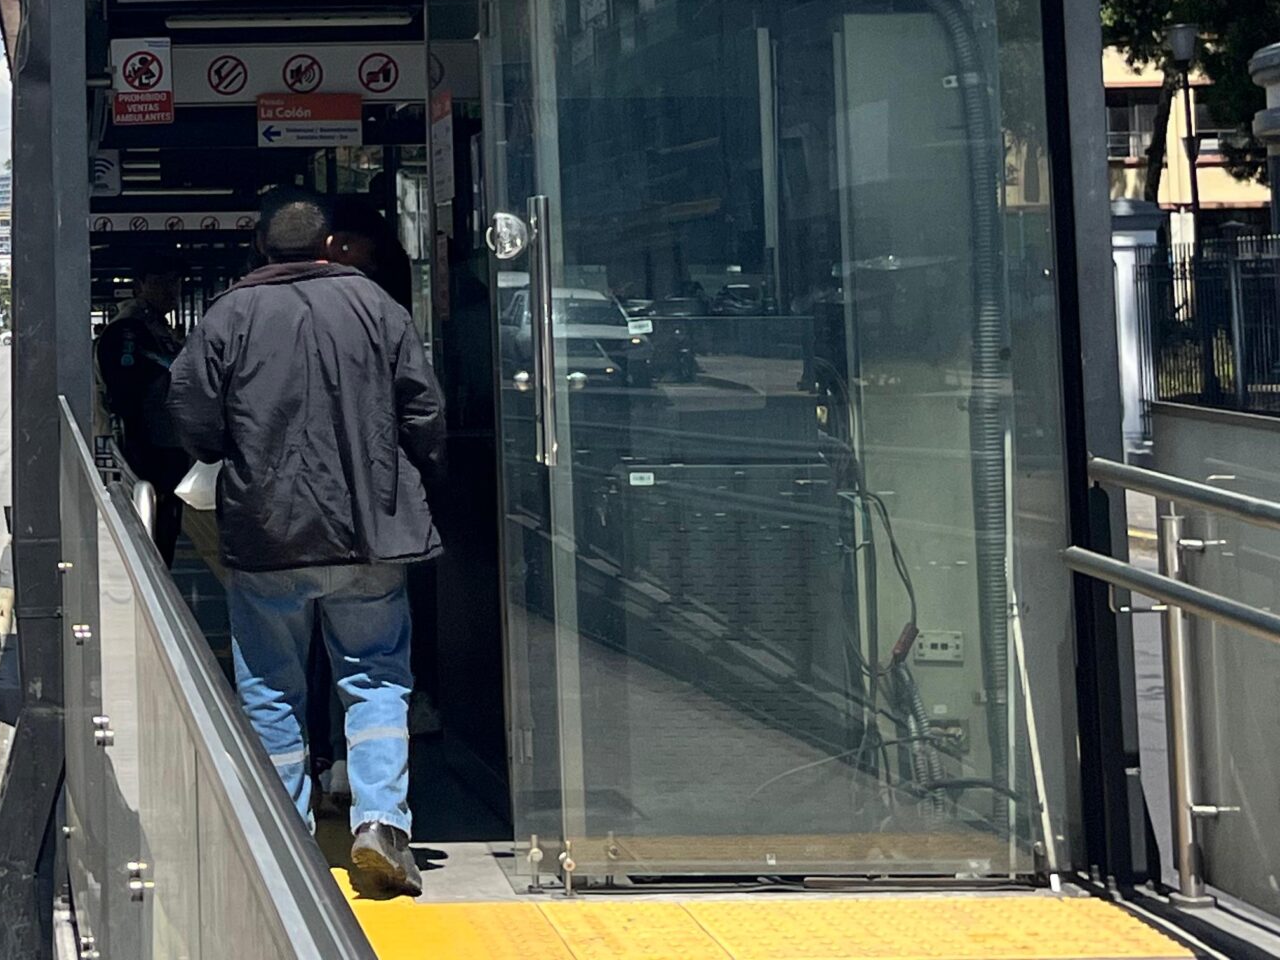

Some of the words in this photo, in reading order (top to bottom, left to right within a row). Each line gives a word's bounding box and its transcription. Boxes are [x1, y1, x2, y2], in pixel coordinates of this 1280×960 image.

[127, 103, 160, 112] VENTAS
[260, 107, 273, 118] La
[275, 106, 312, 118] Colón
[116, 112, 171, 122] AMBULANTES
